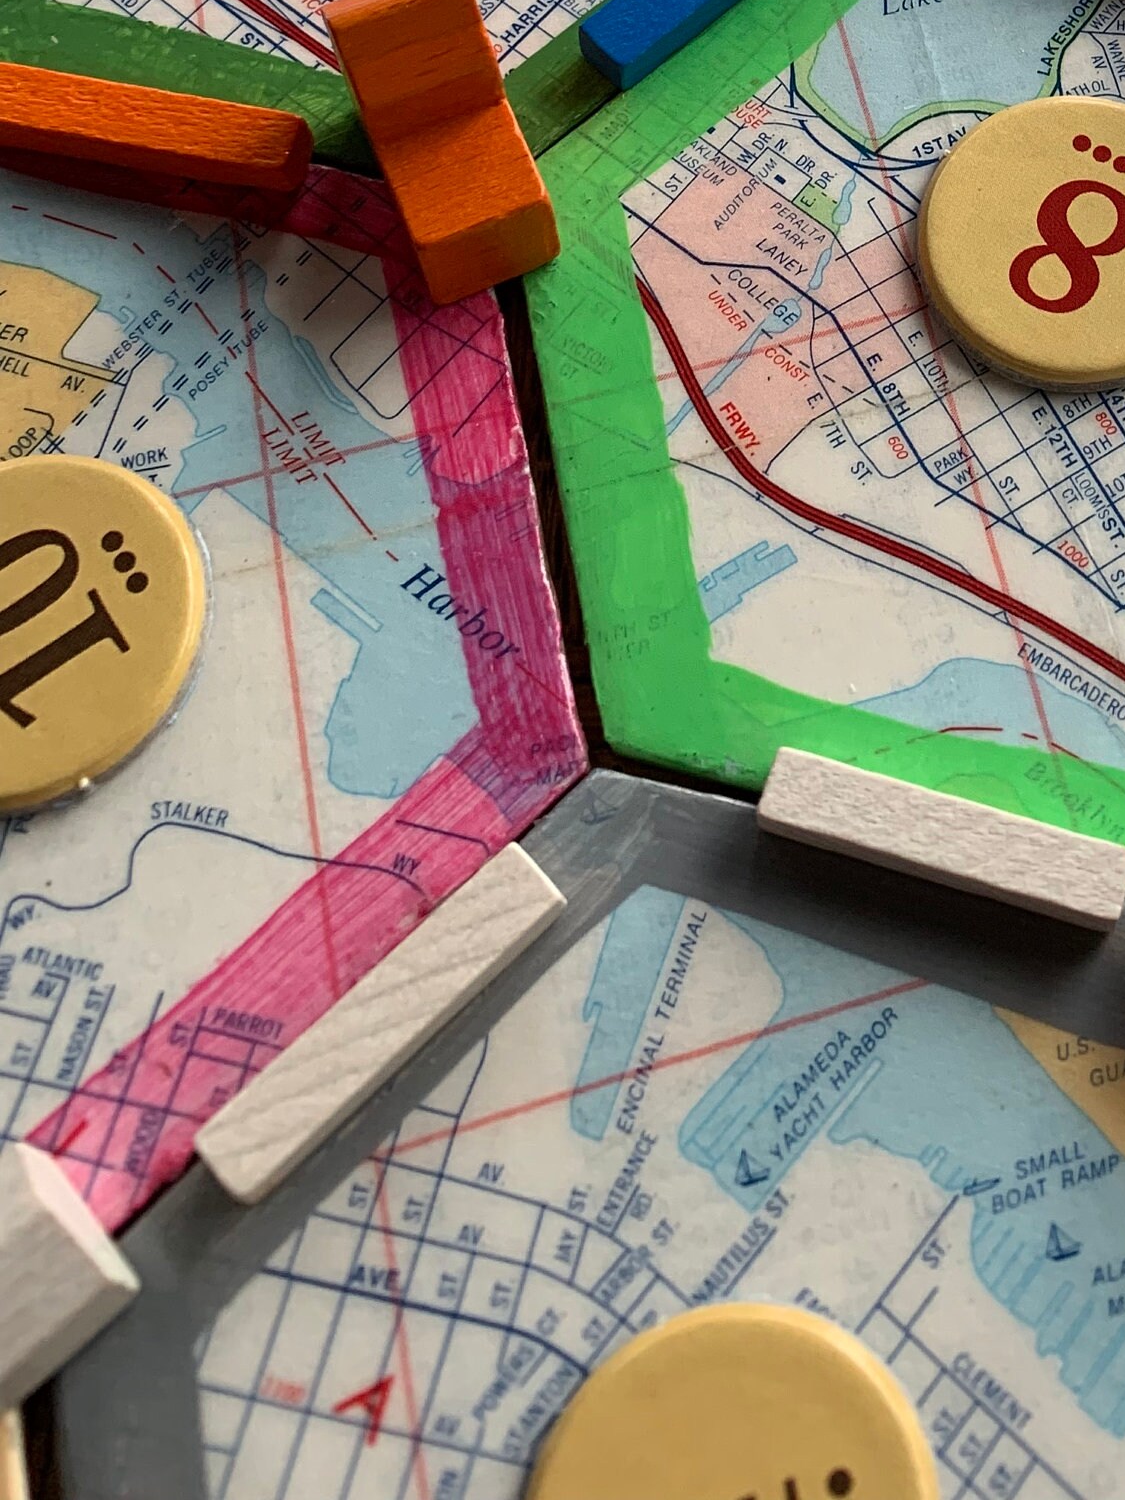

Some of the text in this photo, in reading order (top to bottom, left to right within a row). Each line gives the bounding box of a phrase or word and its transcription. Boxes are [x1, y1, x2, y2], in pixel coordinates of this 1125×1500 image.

[713, 158, 778, 230] AUDITORIUM
[770, 201, 827, 244] PERALTA
[755, 238, 807, 276] LANEY
[772, 220, 809, 249] PARK
[100, 309, 163, 370] WEBSTER
[187, 249, 220, 284] TUBE
[707, 290, 748, 331] UNDER
[727, 269, 798, 326] COLLEGE
[188, 320, 270, 400] POSEY TUBE
[261, 427, 318, 486] LIMIT
[291, 411, 348, 467] LIMIT
[886, 436, 909, 459] 600
[0, 529, 129, 728] 10
[399, 562, 521, 662] Harbor
[150, 801, 229, 828] STALKER
[22, 947, 103, 979] ATLANTIC
[210, 1007, 283, 1039] PARROT
[616, 909, 708, 1134] ENCINAL TERMINAL
[768, 1006, 898, 1162] YACHT HARBOR
[771, 1030, 852, 1123] ALAMEDA
[596, 1131, 658, 1228] ENTRANCE
[991, 1155, 1122, 1214] BOAT RAMP
[1015, 1142, 1085, 1179] SMALL
